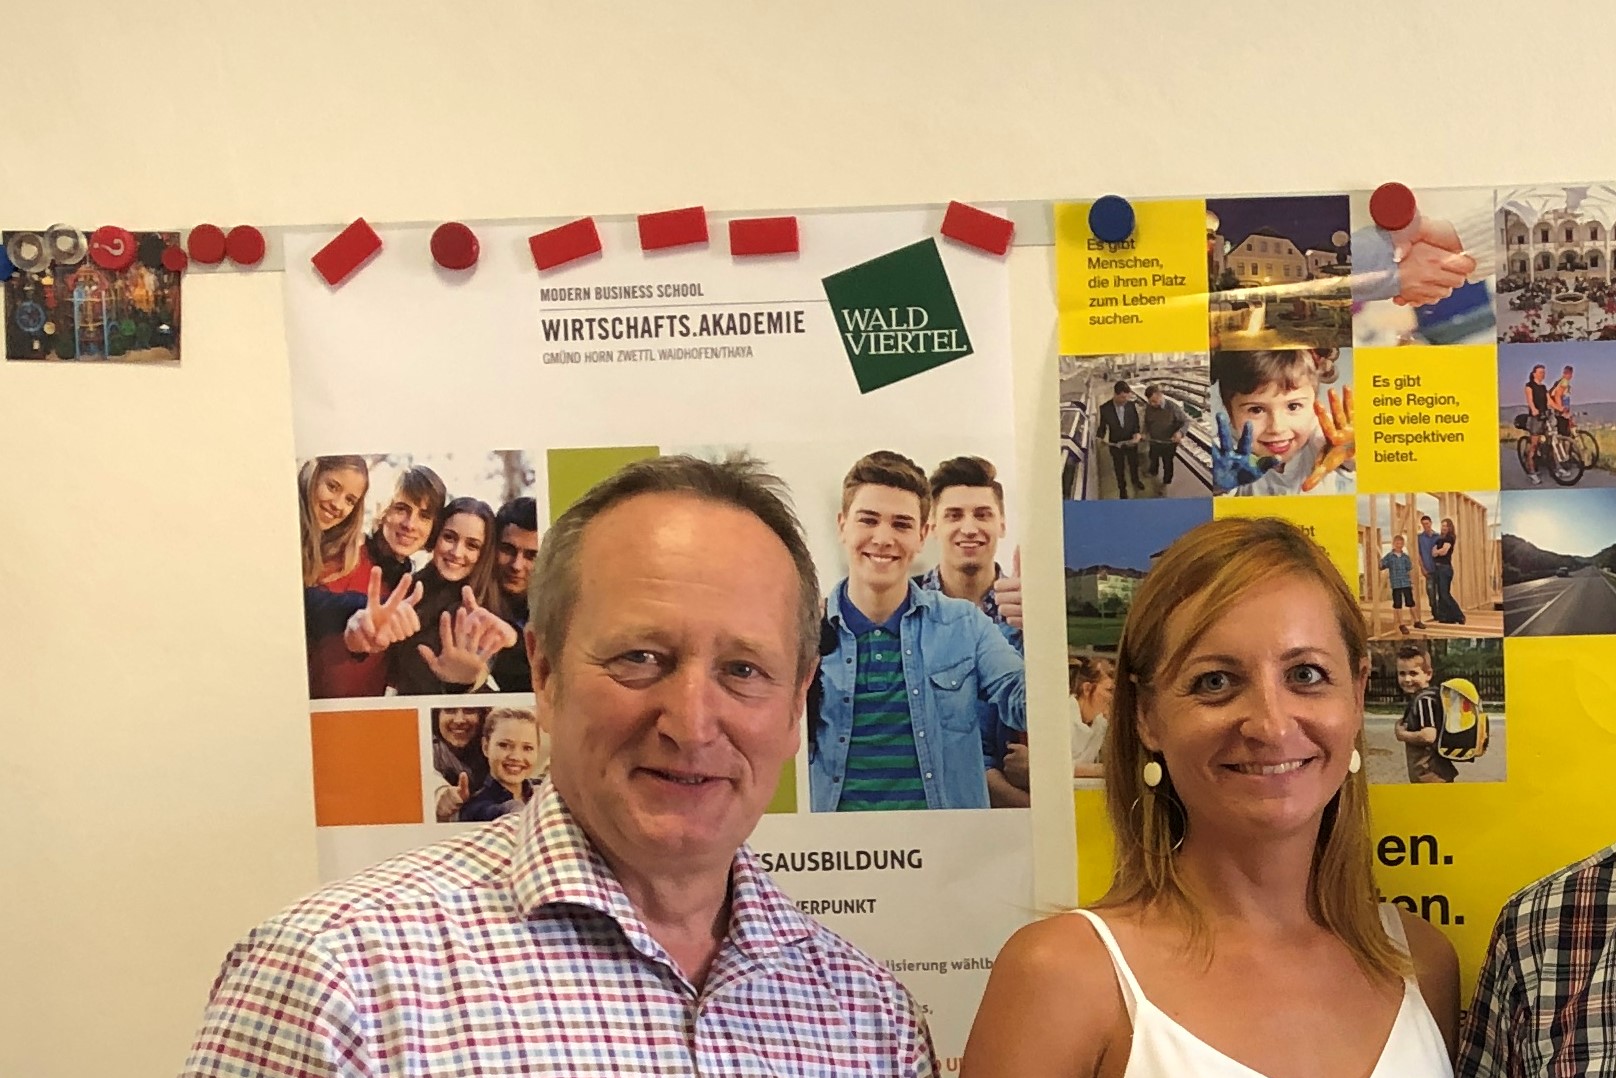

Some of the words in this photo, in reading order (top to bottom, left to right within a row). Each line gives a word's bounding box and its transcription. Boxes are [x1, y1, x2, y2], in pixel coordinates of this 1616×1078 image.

[1087, 238, 1104, 251] Es
[1087, 256, 1163, 270] Menschen,
[1088, 276, 1109, 288] die
[1113, 275, 1147, 288] ihren
[1152, 274, 1187, 286] Platz
[540, 286, 591, 302] MODERN
[595, 284, 653, 301] BUSINESS
[657, 282, 704, 298] SCHOOL
[1089, 297, 1118, 308] zum
[1122, 293, 1166, 306] Leben
[541, 310, 806, 342] WIRTSCHAFTS.AKADEMIE
[841, 306, 929, 331] WALD
[1089, 313, 1143, 325] suchen.
[845, 328, 968, 355] VIERTEL
[542, 349, 581, 365] GMÜND
[584, 350, 614, 364] HORN
[616, 348, 656, 363] ZWETTL
[658, 345, 754, 362] WAIDHOFEN/THAYA
[1372, 375, 1390, 387] Es
[1394, 374, 1421, 390] gibt
[1372, 394, 1402, 407] eine
[1406, 393, 1460, 408] Region,
[1373, 412, 1395, 425] die
[1398, 412, 1431, 424] viele
[1434, 413, 1470, 424] neue
[1374, 430, 1465, 446] Perspektiven
[1374, 450, 1418, 463] bietet.
[796, 899, 877, 914] ERPUNKT
